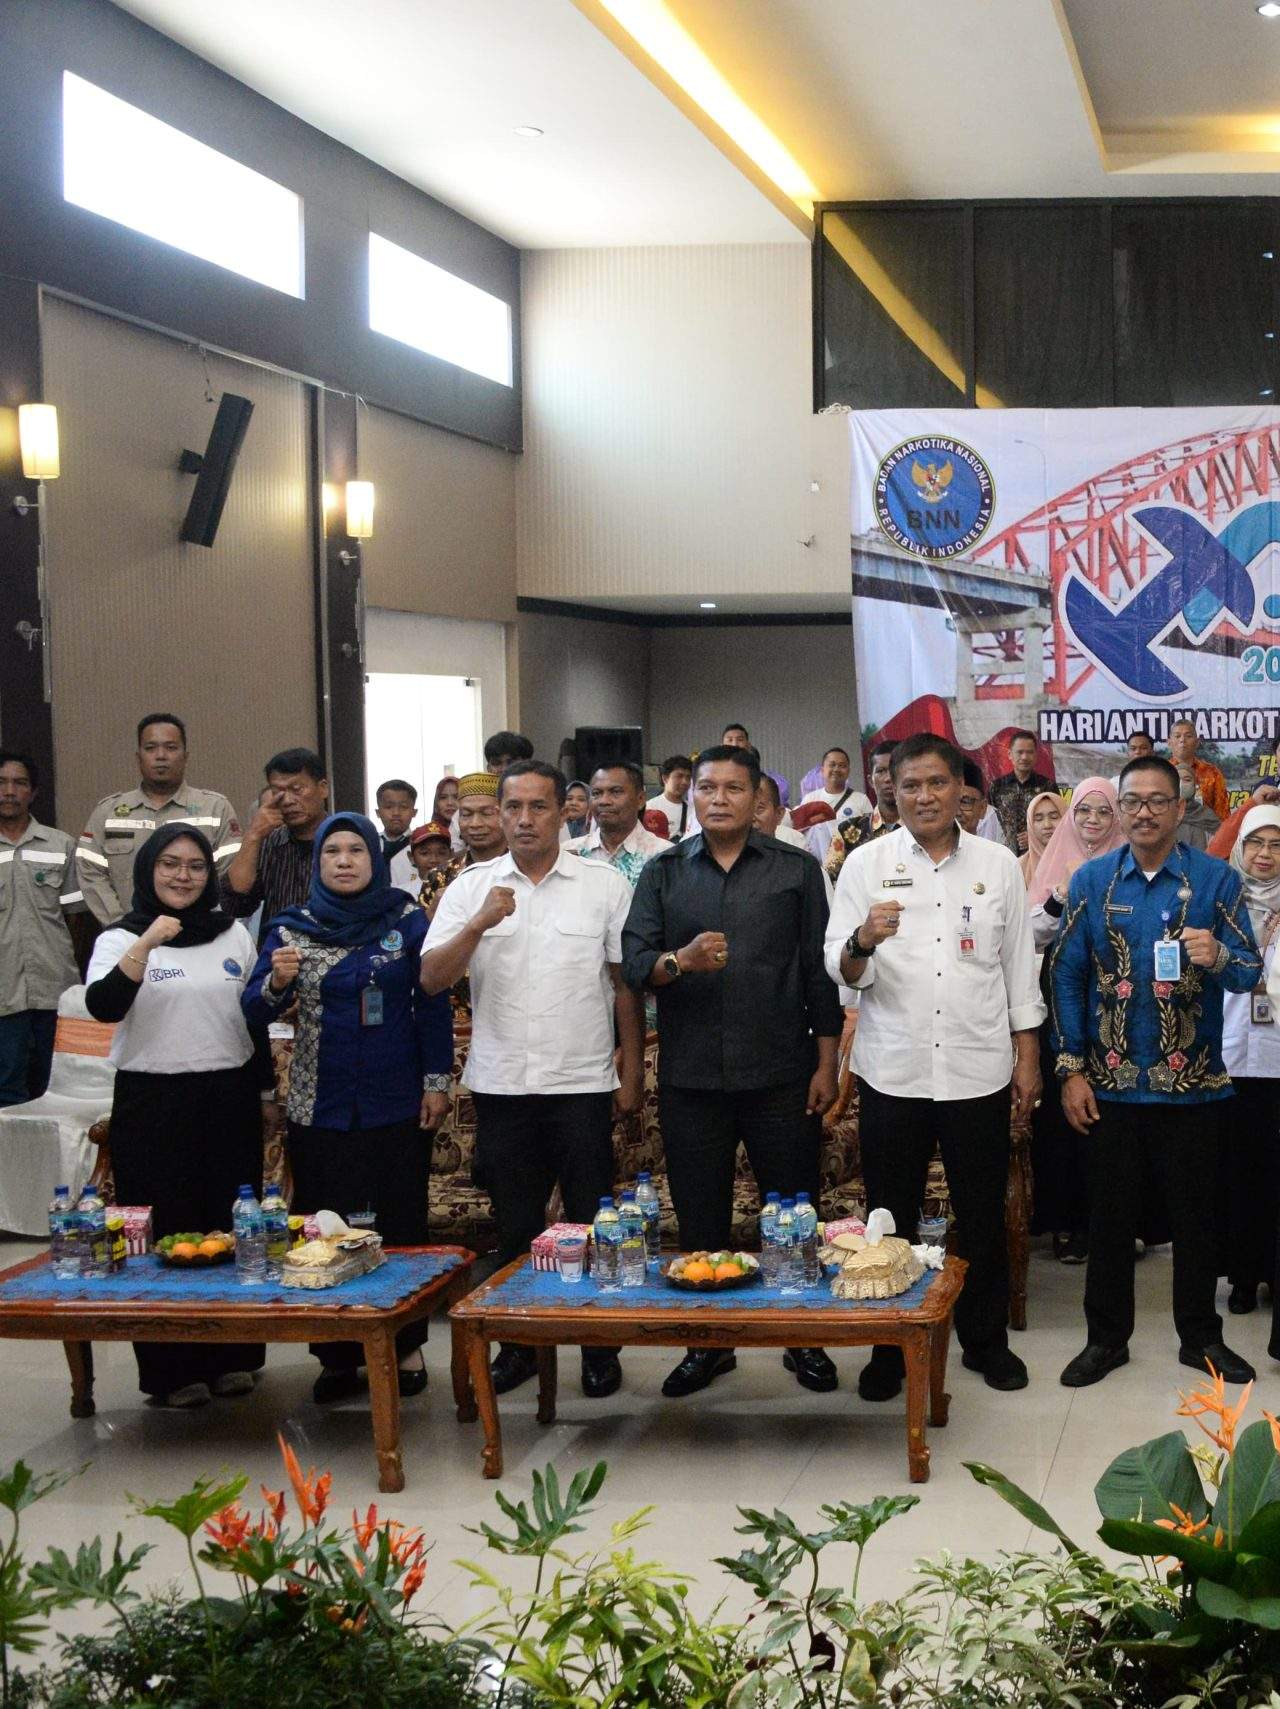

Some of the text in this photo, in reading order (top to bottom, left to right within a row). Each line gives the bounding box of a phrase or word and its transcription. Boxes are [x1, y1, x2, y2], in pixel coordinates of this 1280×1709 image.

[878, 439, 990, 493] BADAN NARKOTIKA NASIONAL
[879, 508, 990, 557] REPUBLIK INDONESIA
[908, 510, 960, 530] BNN
[1040, 711, 1103, 741] HARI
[1107, 711, 1168, 740] ANTI
[163, 968, 186, 979] BRI
